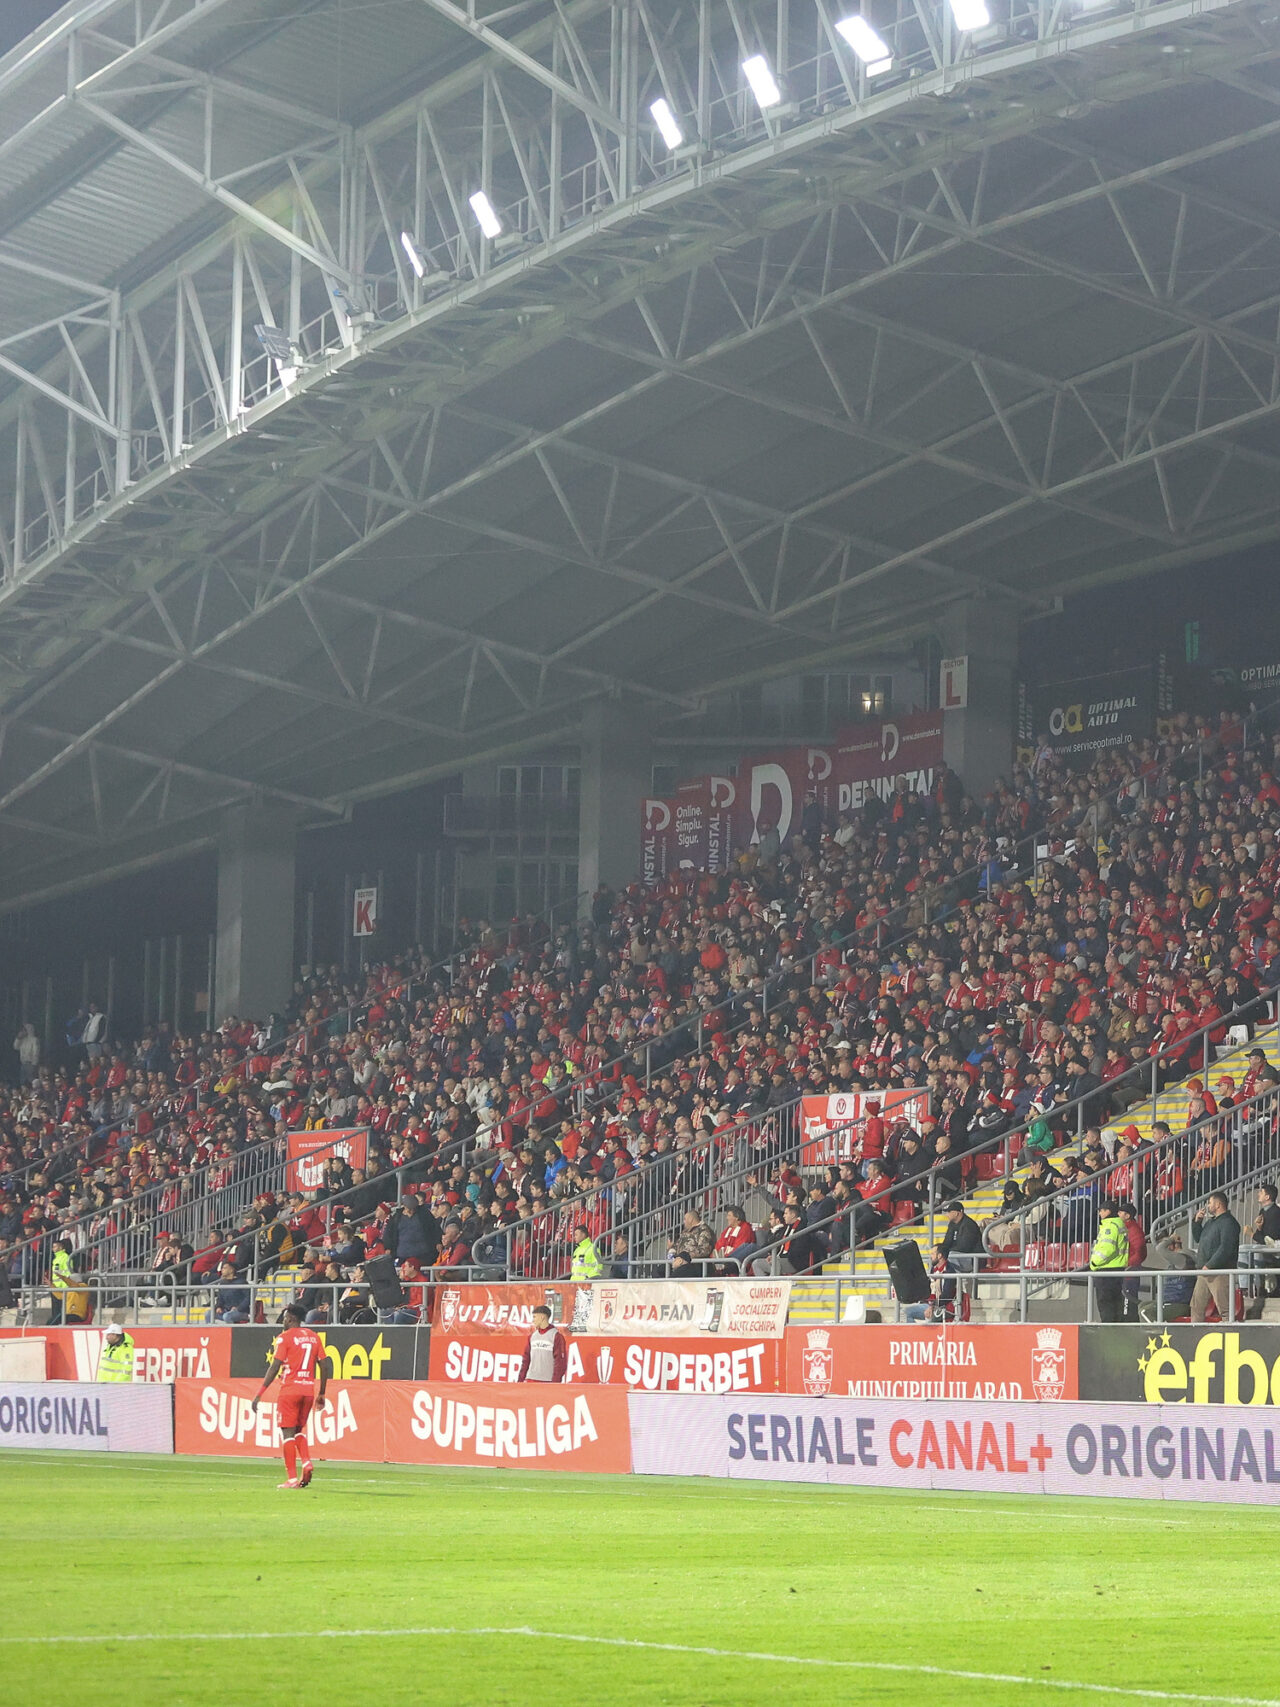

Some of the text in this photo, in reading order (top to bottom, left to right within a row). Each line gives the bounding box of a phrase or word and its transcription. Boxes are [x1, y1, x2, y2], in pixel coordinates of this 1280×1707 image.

[946, 671, 961, 706] L
[1087, 696, 1137, 715] OPTIMAL
[1087, 712, 1119, 728] AUTO
[675, 817, 703, 834] Simplu.
[676, 804, 703, 819] Online.
[678, 833, 699, 848] Sigur.
[709, 812, 720, 875] NINSTAL
[644, 835, 656, 886] INSTAL
[357, 900, 373, 933] K
[749, 1287, 782, 1299] CUMPERI
[458, 1304, 534, 1323] UTAFAN
[622, 1304, 694, 1321] UTAFAN
[301, 1342, 313, 1370] 7
[315, 1331, 392, 1380] bet
[445, 1340, 586, 1383] SUPERA
[889, 1335, 978, 1367] PRIMĂRIA
[623, 1342, 766, 1393] SUPERBET
[973, 1381, 1023, 1400] ARAD
[0, 1395, 109, 1437] ORIGINAL
[199, 1386, 359, 1449] SUPEIGA
[411, 1389, 599, 1459] SUPERLIGA
[727, 1412, 878, 1467] SERIALE
[888, 1418, 1053, 1473] CANAL+
